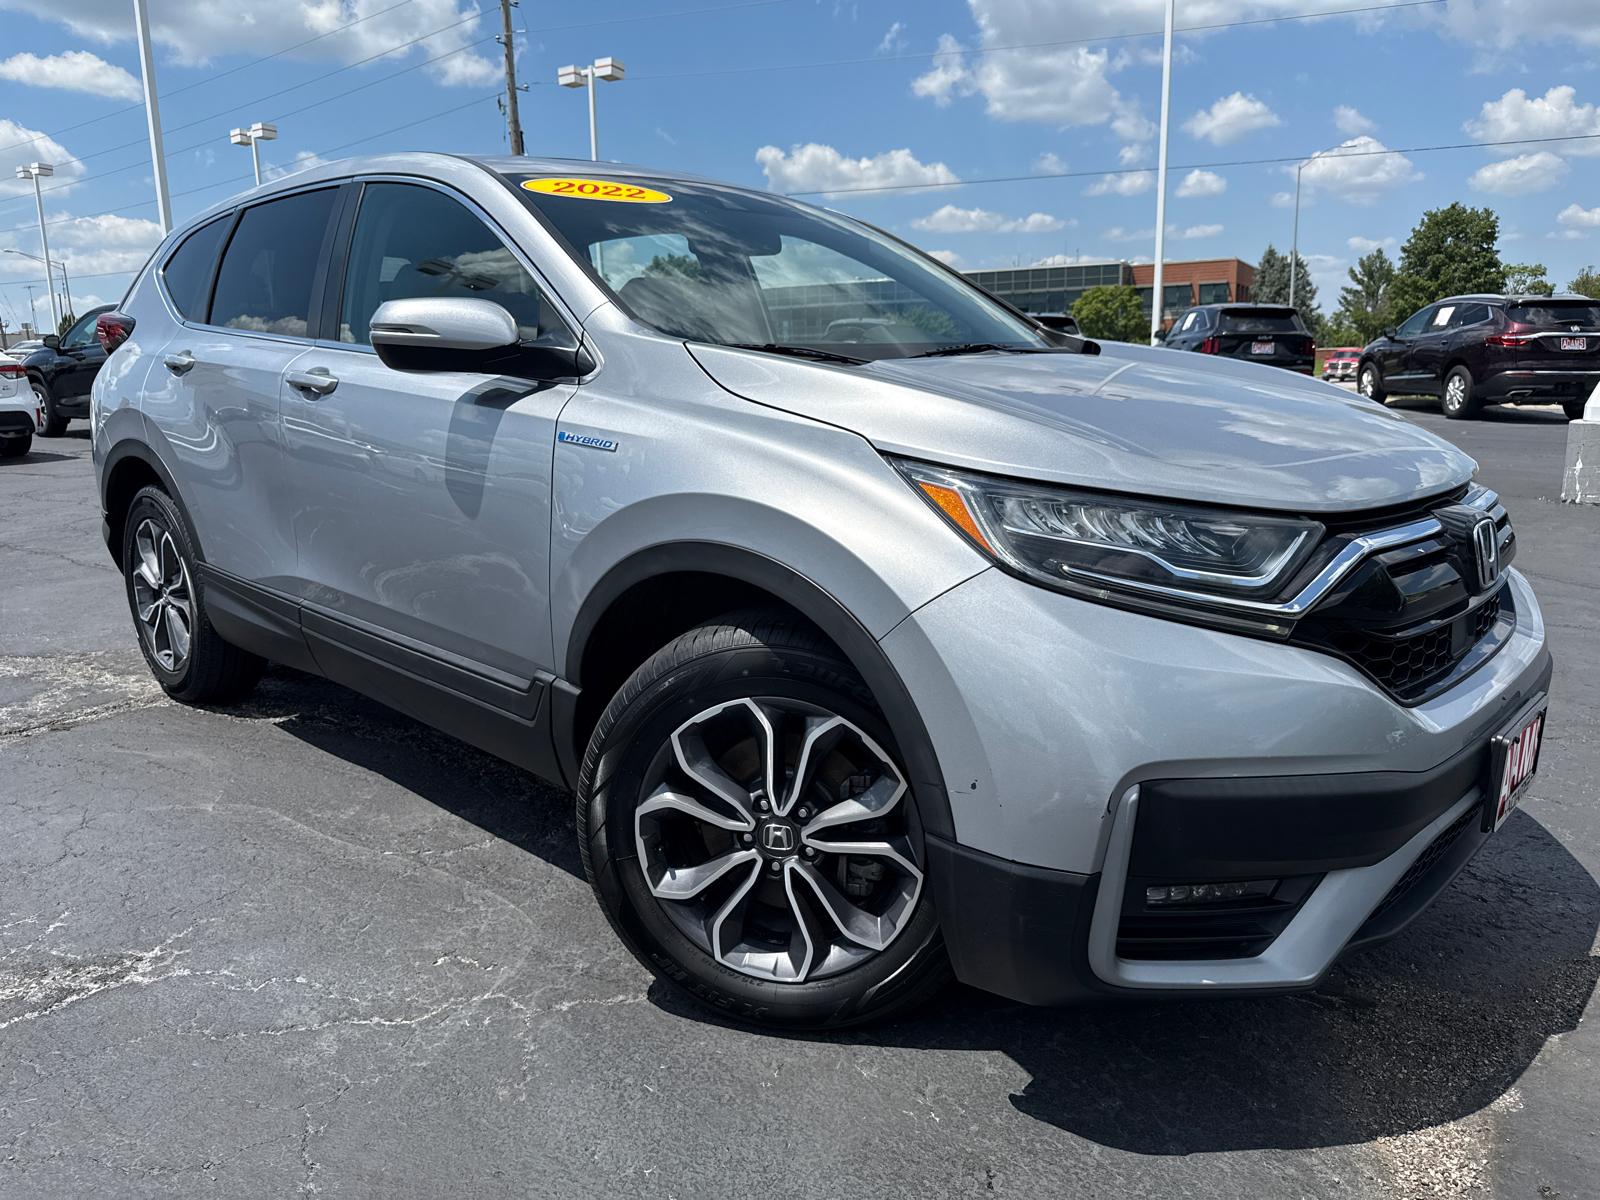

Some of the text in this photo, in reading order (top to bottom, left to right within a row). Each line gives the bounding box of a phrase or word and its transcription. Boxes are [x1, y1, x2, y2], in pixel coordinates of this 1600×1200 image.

[552, 182, 646, 199] 2022
[1563, 339, 1584, 348] ADAMS
[566, 434, 613, 448] HYBRID
[650, 953, 688, 981] HP
[688, 983, 736, 1009] FIT
